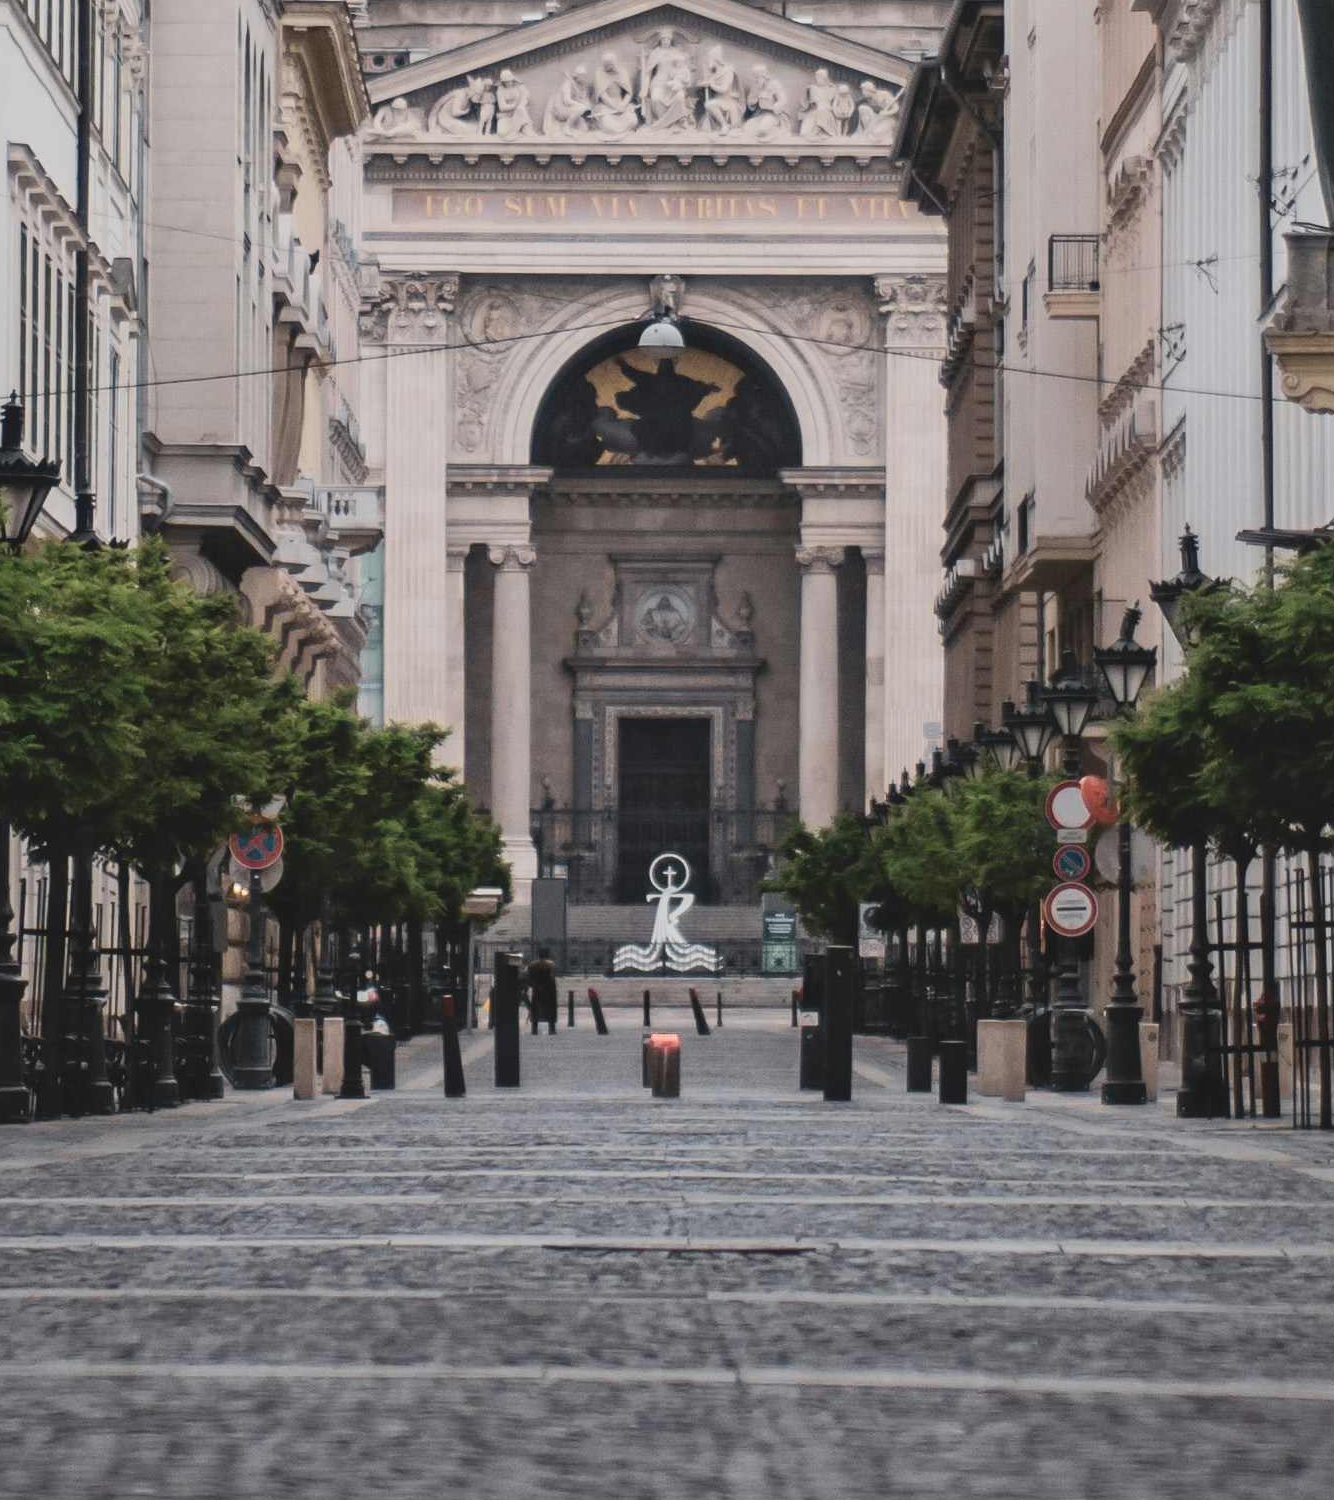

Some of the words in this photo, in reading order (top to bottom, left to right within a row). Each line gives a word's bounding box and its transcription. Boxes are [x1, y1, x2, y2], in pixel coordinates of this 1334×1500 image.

[423, 195, 485, 218] EGO
[504, 195, 567, 218] SUM
[590, 196, 642, 219] VIA
[660, 196, 778, 219] VERITAS
[796, 197, 830, 219] ET
